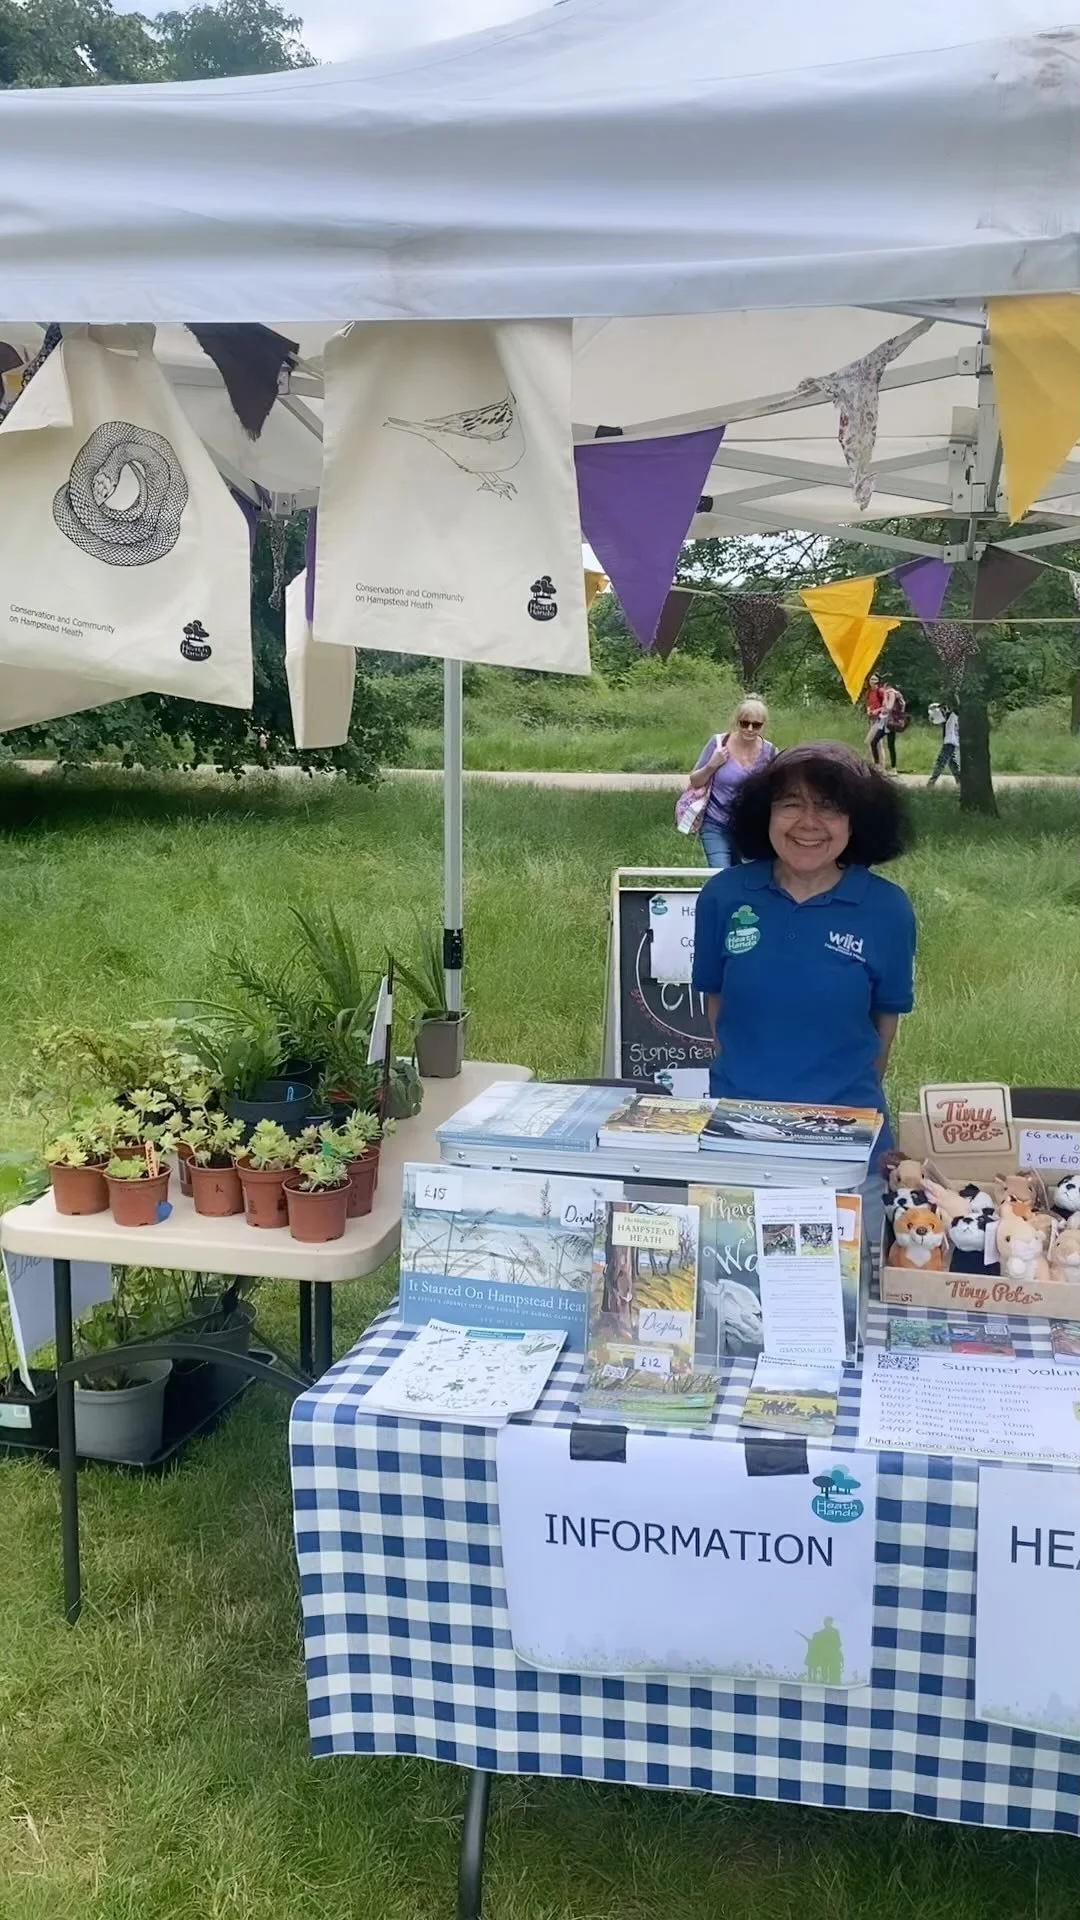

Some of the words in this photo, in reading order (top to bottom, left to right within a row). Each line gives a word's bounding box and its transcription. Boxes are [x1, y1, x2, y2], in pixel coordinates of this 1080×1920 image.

[355, 582, 404, 596] Conservation
[406, 589, 420, 598] and
[421, 590, 464, 603] Community
[355, 595, 365, 603] on
[366, 595, 409, 609] Hampstead
[411, 600, 433, 610] Heath
[9, 615, 19, 624] on
[20, 617, 59, 633] Hampstead
[61, 625, 84, 638] Heath
[10, 603, 55, 621] Conservation
[57, 615, 70, 625] and
[72, 617, 115, 635] Community
[629, 1042, 686, 1062] Stories
[936, 1098, 996, 1132] Tiny
[942, 1122, 998, 1145] Pets
[1026, 1153, 1033, 1162] 2
[1038, 1154, 1056, 1165] for
[1060, 1154, 1079, 1164] £10
[424, 1186, 448, 1201] £15
[617, 1224, 675, 1237] HAMPSTEAD
[630, 1234, 662, 1245] HEATH
[409, 1279, 418, 1292] It
[421, 1281, 461, 1297] Started
[465, 1286, 484, 1300] On
[488, 1288, 554, 1309] Hampstead
[946, 1279, 990, 1308] Tiny
[992, 1283, 1036, 1304] Pets
[641, 1357, 661, 1368] £12
[942, 1362, 1020, 1375] Summer
[869, 1436, 891, 1445] Find
[916, 1429, 976, 1442] Gardening
[817, 1500, 858, 1511] Heath
[544, 1512, 833, 1567] INFORMATION
